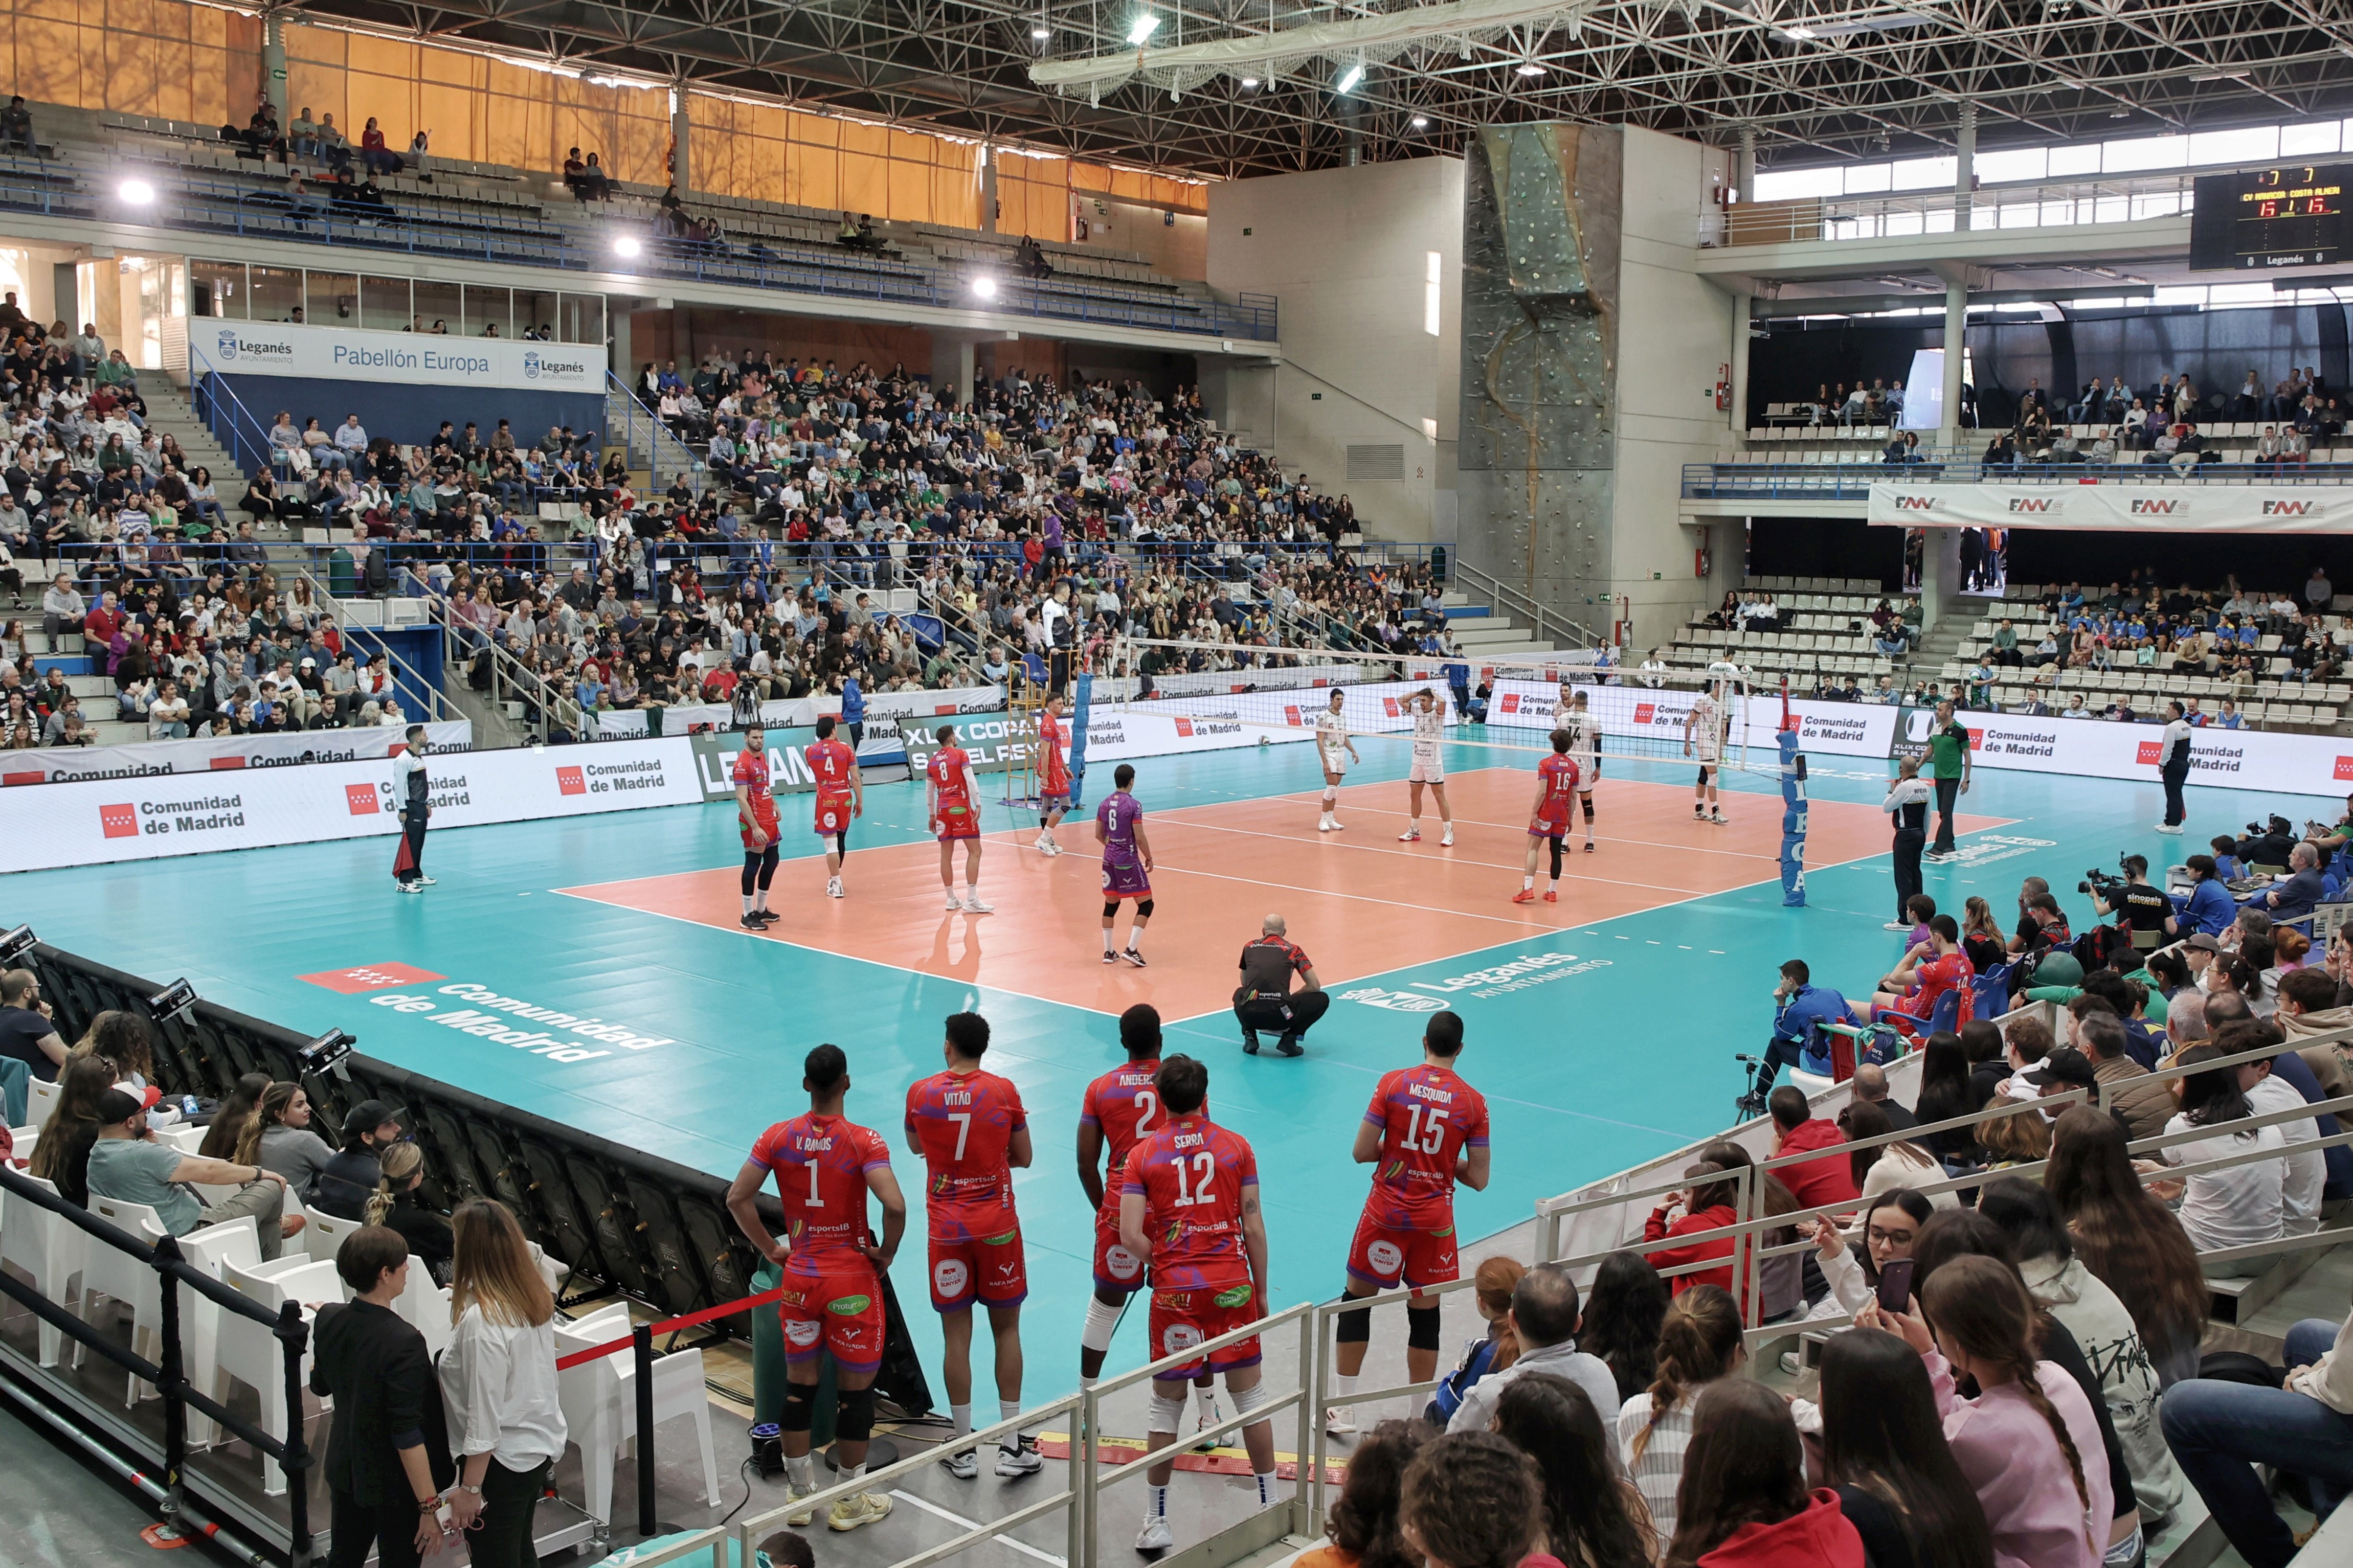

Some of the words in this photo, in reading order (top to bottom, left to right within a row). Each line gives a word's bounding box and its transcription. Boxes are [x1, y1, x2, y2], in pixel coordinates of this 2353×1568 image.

[2267, 255, 2304, 265] Leganés
[239, 339, 293, 356] Leganés
[240, 354, 293, 364] AYUNTAMIENTO
[334, 346, 417, 369] Pabellón
[423, 351, 490, 375] Europa
[541, 360, 585, 374] Leganés
[542, 373, 585, 381] AYUNTAMIENTO
[1559, 673, 1567, 682] de
[1568, 671, 1593, 681] Madrid
[1522, 695, 1557, 705] Comuni
[1520, 706, 1532, 715] de
[1304, 716, 1314, 725] de
[1655, 715, 1669, 725] de
[1804, 715, 1867, 729] Comunidad
[904, 724, 967, 746] XLX
[1196, 725, 1207, 735] de
[1209, 723, 1241, 735] Madrid
[1802, 727, 1818, 738] de
[1821, 729, 1864, 741] Madrid
[1987, 730, 2056, 743] Comunidad
[1090, 733, 1125, 745] Madrid
[1985, 742, 2002, 753] de
[2005, 743, 2054, 757] Madrid
[587, 759, 662, 776] Comunidad
[824, 756, 835, 775] 4
[939, 761, 949, 781] 8
[590, 780, 609, 793] de
[613, 775, 665, 791] Madrid
[1555, 772, 1572, 790] 16
[141, 794, 241, 815] Comunidad
[428, 792, 470, 808] adrid
[145, 819, 169, 835] de
[176, 812, 245, 832] Madrid
[1108, 809, 1117, 831] 6
[2127, 893, 2162, 903] sinopsis
[1408, 952, 1578, 993] Leganés
[1470, 959, 1614, 999] AYUNTAMIENTO
[437, 983, 677, 1050] Comunidad
[368, 994, 437, 1012] de
[423, 1009, 613, 1063] Madrid
[944, 1090, 971, 1106] VITÃO
[1408, 1082, 1452, 1104] MESQUIDA
[1134, 1090, 1156, 1139] 2
[948, 1112, 971, 1161] 7
[1400, 1104, 1450, 1154] 15
[796, 1135, 802, 1150] V.
[804, 1137, 832, 1151] RAMOS
[1174, 1132, 1204, 1149] SERRA
[804, 1158, 825, 1208] 1
[1170, 1151, 1216, 1208] 12
[808, 1222, 850, 1234] esportsIB
[1374, 1257, 1394, 1266] SUNYER
[940, 1278, 961, 1288] SUNYER
[833, 1299, 868, 1310] Proturcars
